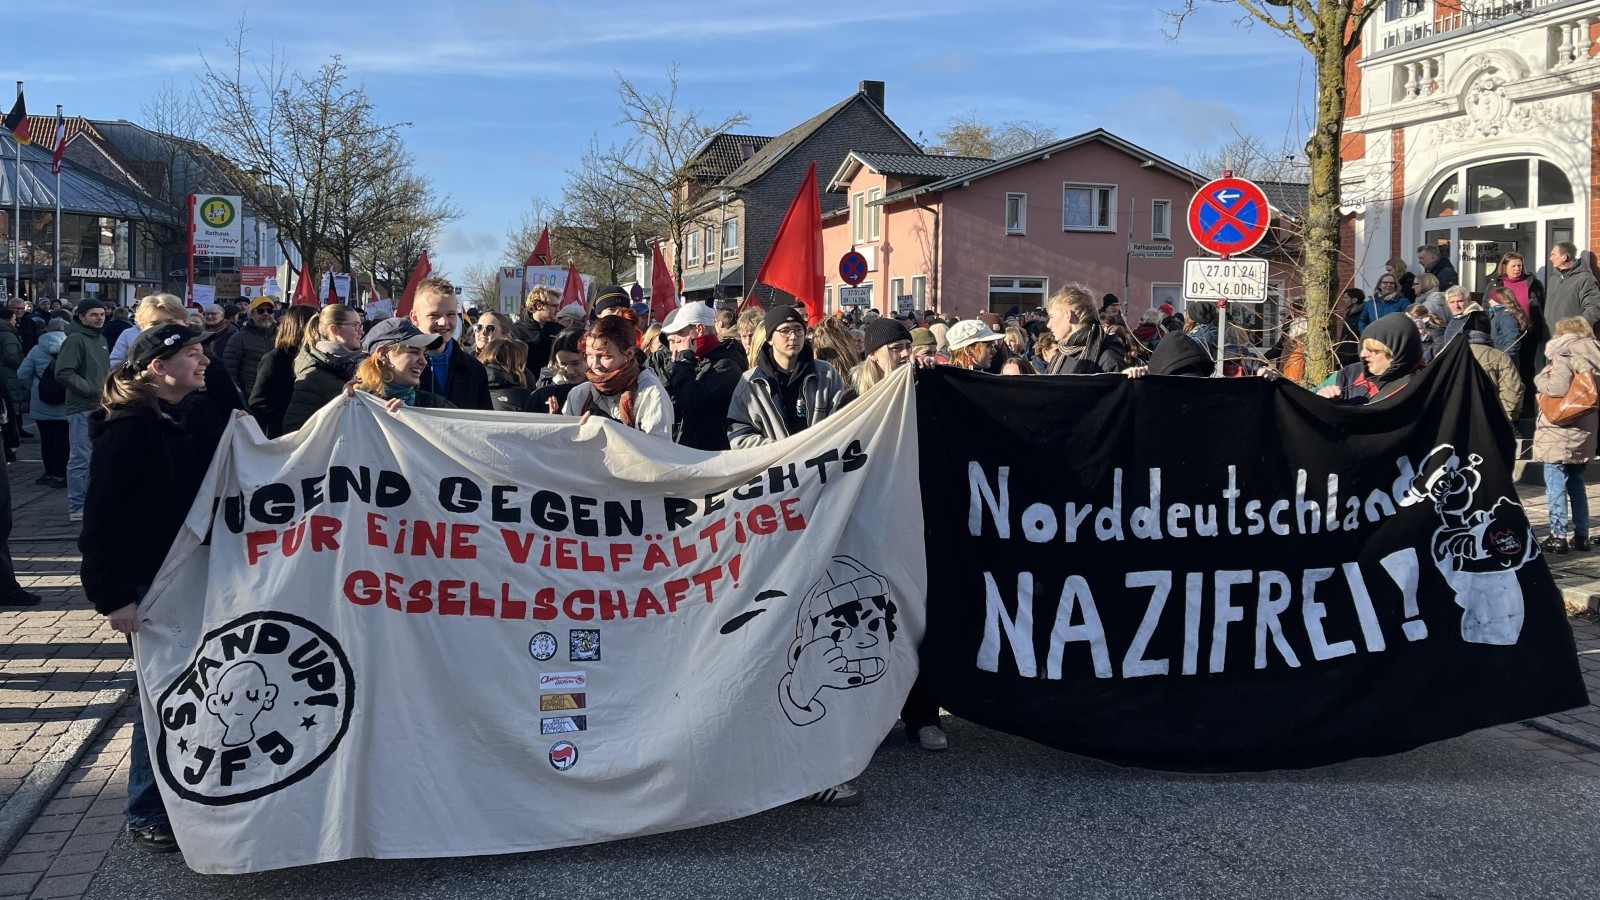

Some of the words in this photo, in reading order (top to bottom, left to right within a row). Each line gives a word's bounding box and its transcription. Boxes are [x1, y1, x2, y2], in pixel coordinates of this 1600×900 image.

[71, 267, 97, 277] LUKAS
[97, 269, 130, 280] LOUNGE
[1206, 265, 1255, 277] 27.01.24
[438, 476, 643, 537] GEGEN
[663, 440, 868, 532] RECHTS
[968, 455, 1421, 543] Norddeutschland
[246, 515, 342, 566] FÜR
[343, 554, 742, 621] GESELLSCHAFT!
[976, 547, 1429, 680] NAZIFREI!
[163, 622, 290, 730] STAND
[287, 637, 339, 708] UP!
